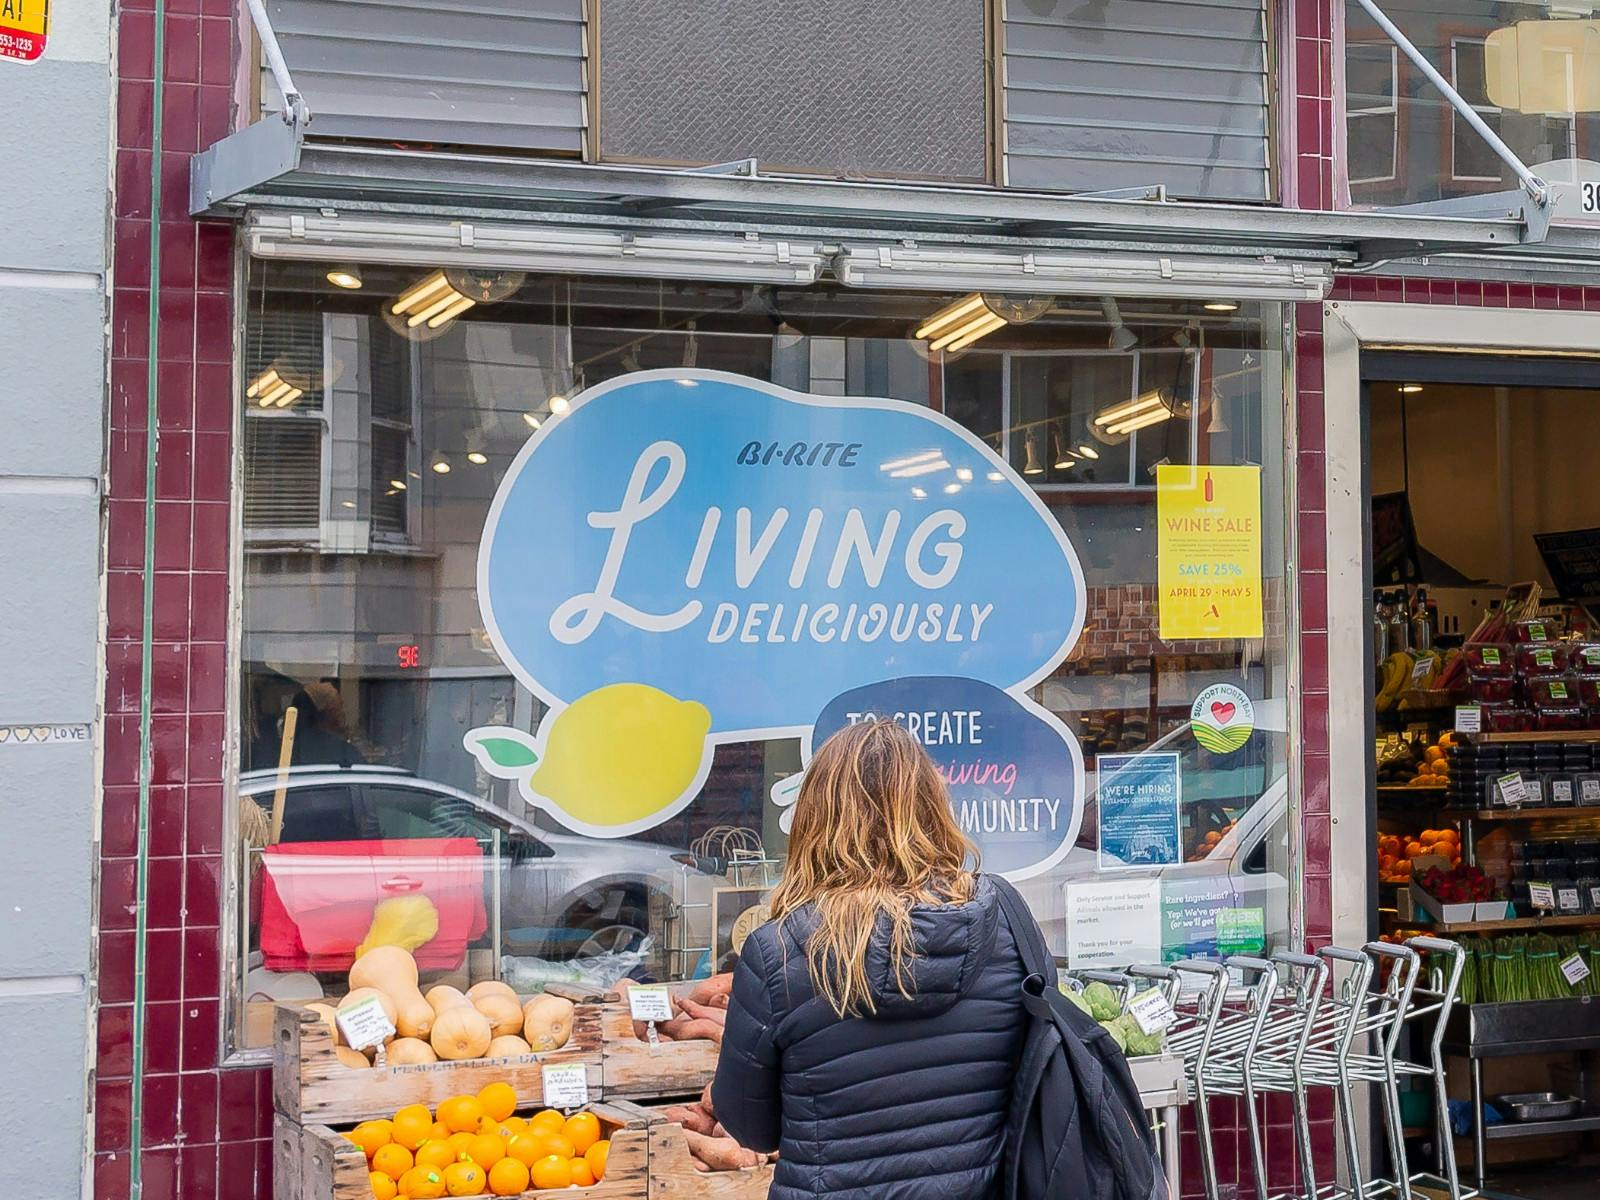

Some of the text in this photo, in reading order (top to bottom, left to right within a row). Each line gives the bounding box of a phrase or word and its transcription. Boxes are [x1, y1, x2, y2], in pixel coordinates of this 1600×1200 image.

[1166, 517, 1252, 532] WINE SALE
[549, 440, 967, 645] LIVING
[1178, 563, 1242, 576] SAVE 25%
[1169, 588, 1197, 598] APRIL
[1199, 587, 1212, 598] 29
[1222, 587, 1243, 597] MAY
[1245, 587, 1251, 597] 5
[706, 602, 994, 644] DELICIOUSLY
[1194, 688, 1219, 718] SUPPORT
[1220, 687, 1245, 706] NORTH
[53, 727, 85, 741] LOVE
[1105, 784, 1172, 796] WE'RE HIRING
[1165, 890, 1229, 905] Rare ingredient?
[1167, 910, 1184, 919] Yep!
[1184, 907, 1208, 917] We've
[1183, 919, 1200, 927] we'll
[1201, 917, 1214, 927] get
[1077, 941, 1096, 949] Thank
